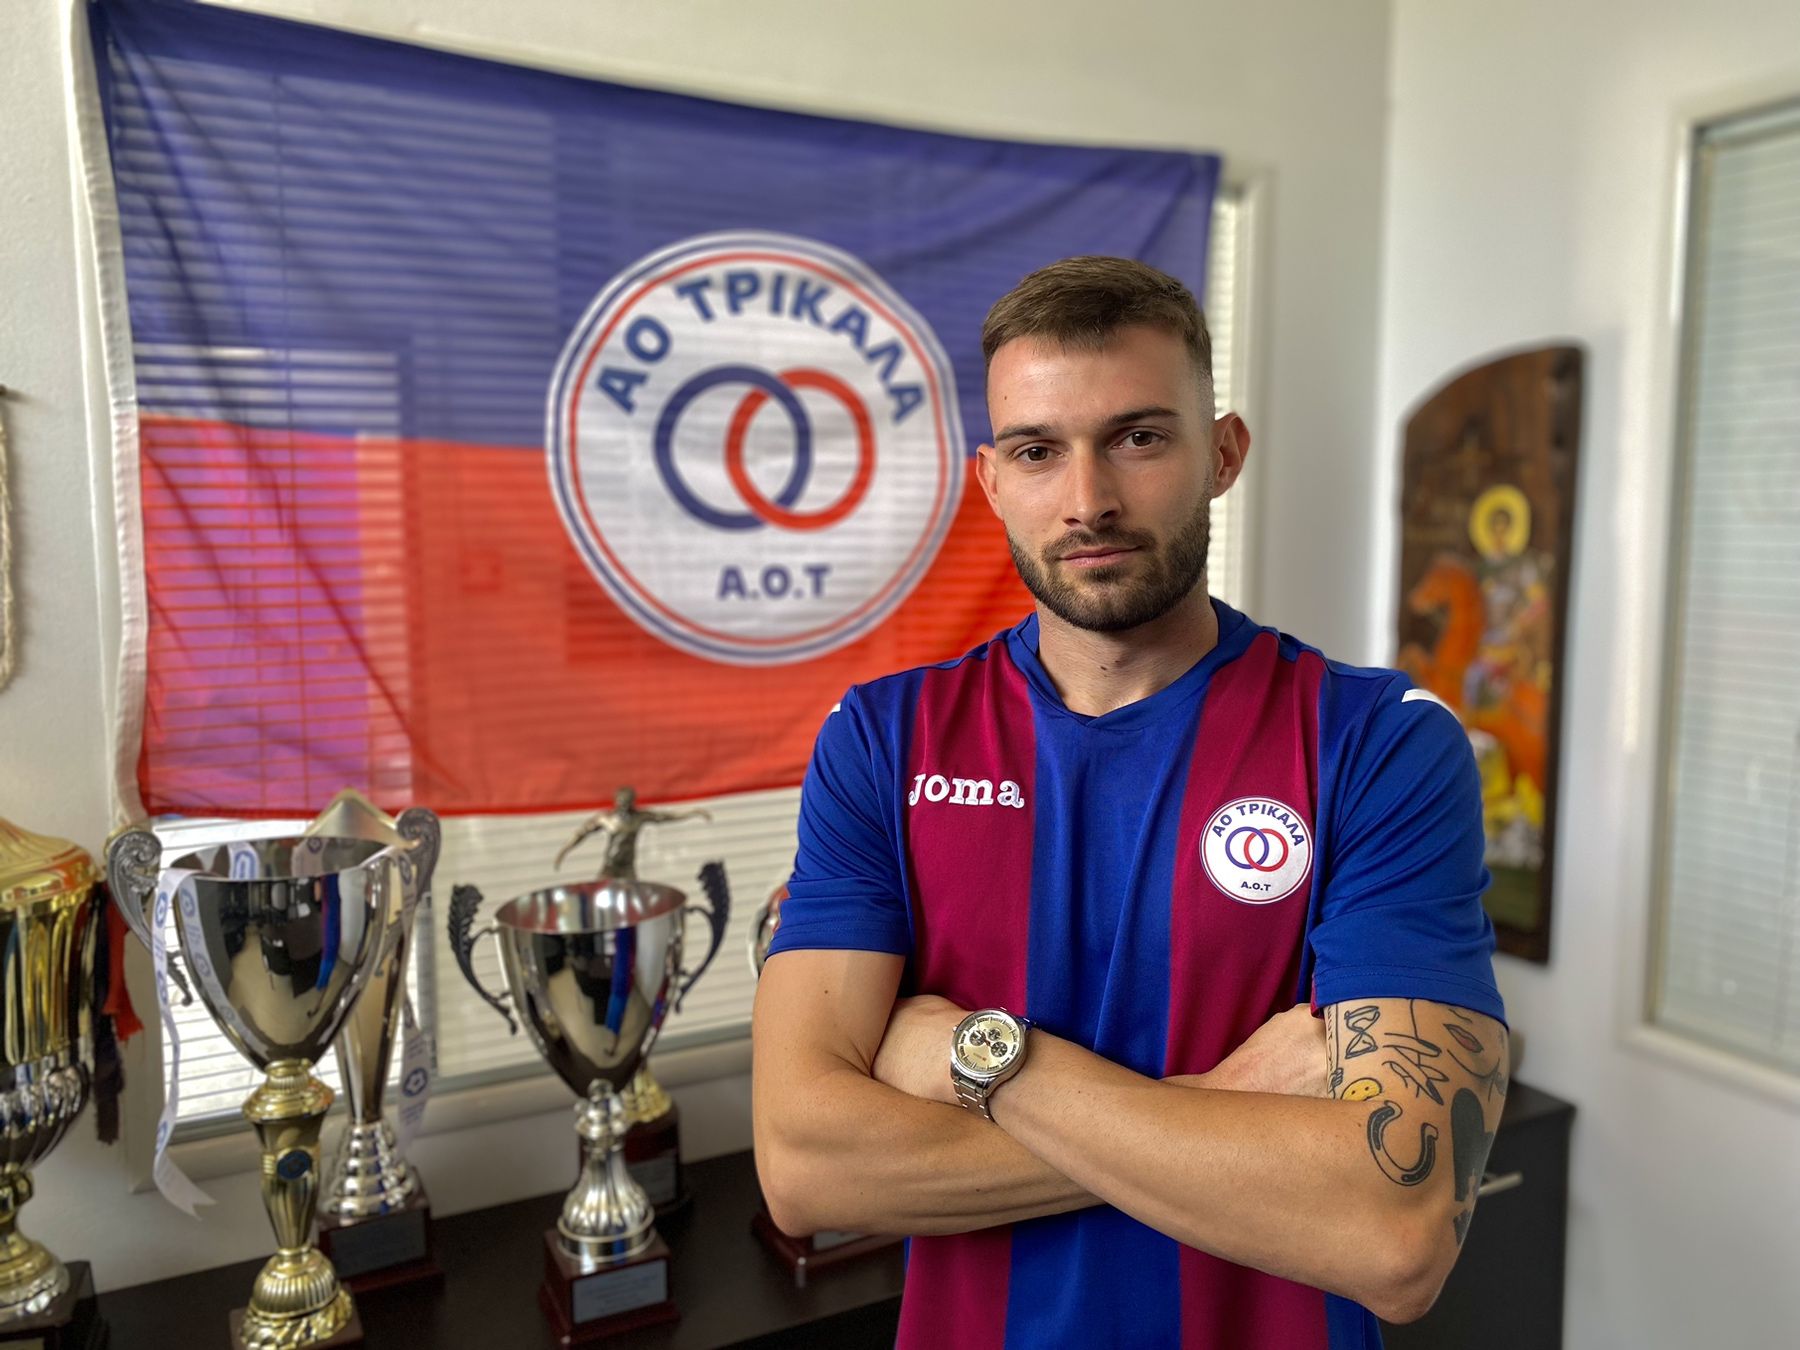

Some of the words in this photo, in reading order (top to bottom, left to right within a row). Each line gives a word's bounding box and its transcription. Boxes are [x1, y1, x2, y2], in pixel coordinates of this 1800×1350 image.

[597, 316, 671, 413] ΑΟ
[676, 270, 926, 423] ΤΡΙΚΑΛΑ
[719, 566, 829, 599] Α.Ο.Τ
[1212, 814, 1232, 837] ΑΟ
[1236, 804, 1305, 846] ΤΡΙΚΑΛΑ
[1241, 881, 1271, 891] Α.Ο.Τ
